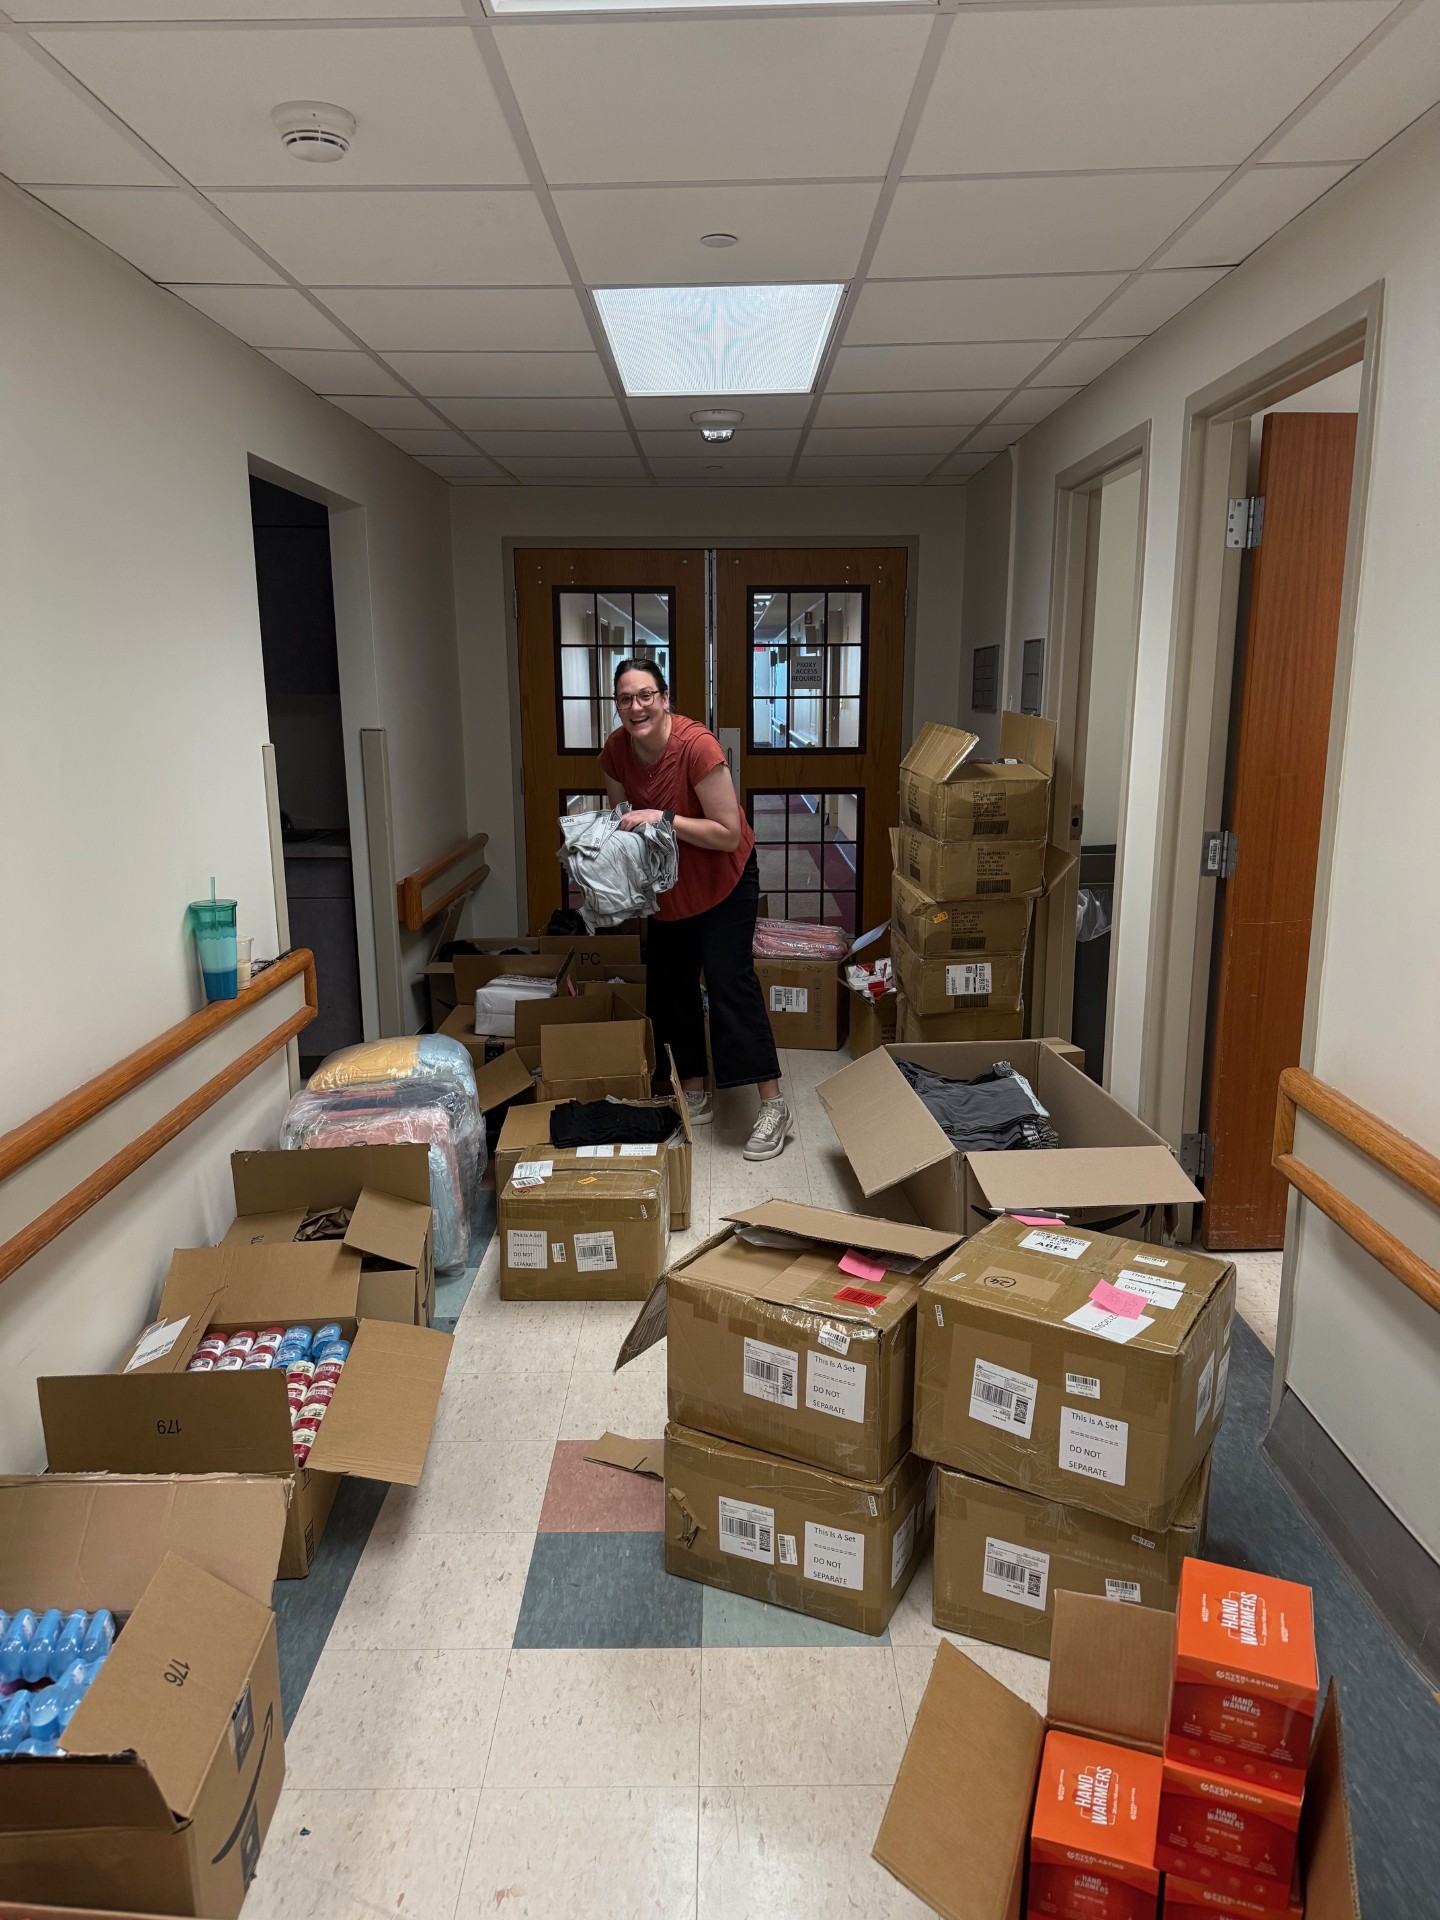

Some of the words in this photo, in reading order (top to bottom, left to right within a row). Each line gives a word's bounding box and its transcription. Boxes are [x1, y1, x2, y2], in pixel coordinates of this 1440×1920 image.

[580, 952, 601, 966] PC
[1138, 1287, 1157, 1295] NOT
[814, 1355, 828, 1366] This
[829, 1359, 836, 1368] Is
[836, 1362, 843, 1370] A
[843, 1364, 856, 1373] Set
[813, 1385, 824, 1394] DO
[825, 1388, 840, 1398] NOT
[812, 1399, 846, 1416] SEPARATE
[157, 1419, 182, 1434] 179
[1071, 1411, 1087, 1423] This
[1089, 1416, 1095, 1425] Is
[1096, 1419, 1104, 1427] A
[1105, 1421, 1119, 1432] Set
[1069, 1444, 1082, 1454] DO
[1083, 1448, 1102, 1459] NOT
[1068, 1460, 1108, 1478] SEPARATE
[814, 1526, 829, 1537] This
[843, 1534, 856, 1543] Set
[813, 1556, 824, 1565] DO
[826, 1559, 842, 1569] NOT
[813, 1570, 848, 1585] SEPARATE
[1220, 1598, 1239, 1630] HAND
[1240, 1591, 1259, 1646] WARMERS
[163, 1658, 191, 1687] 176
[1225, 1672, 1279, 1690] EVERLASTING
[1222, 1699, 1261, 1717] WARMERS
[1231, 1694, 1254, 1706] HAND
[1074, 1774, 1093, 1808] HAND
[1091, 1766, 1112, 1825] WARMERS
[1209, 1784, 1262, 1804] EVERLASTING
[1207, 1812, 1245, 1831] WARMERS
[1215, 1808, 1237, 1820] HAND
[1074, 1878, 1109, 1896] WARMERS
[1082, 1874, 1102, 1885] HAND
